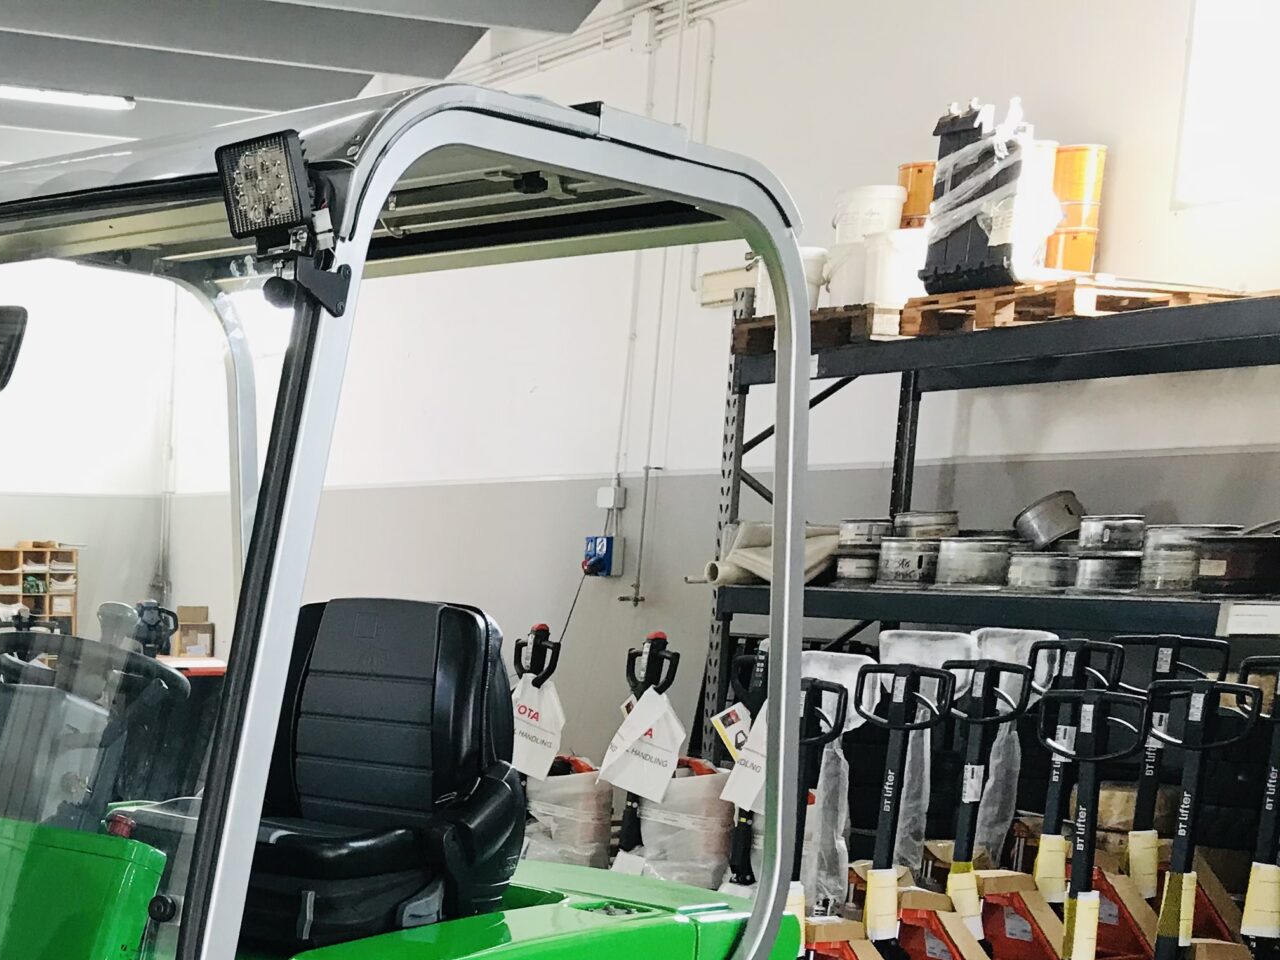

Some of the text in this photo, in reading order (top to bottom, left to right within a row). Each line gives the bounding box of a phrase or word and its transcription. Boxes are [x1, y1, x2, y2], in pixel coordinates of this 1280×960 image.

[518, 729, 553, 749] HANDLING
[630, 747, 668, 768] HANDLING
[883, 798, 891, 812] BT
[1177, 822, 1186, 837] BT
[1076, 836, 1085, 851] BT
